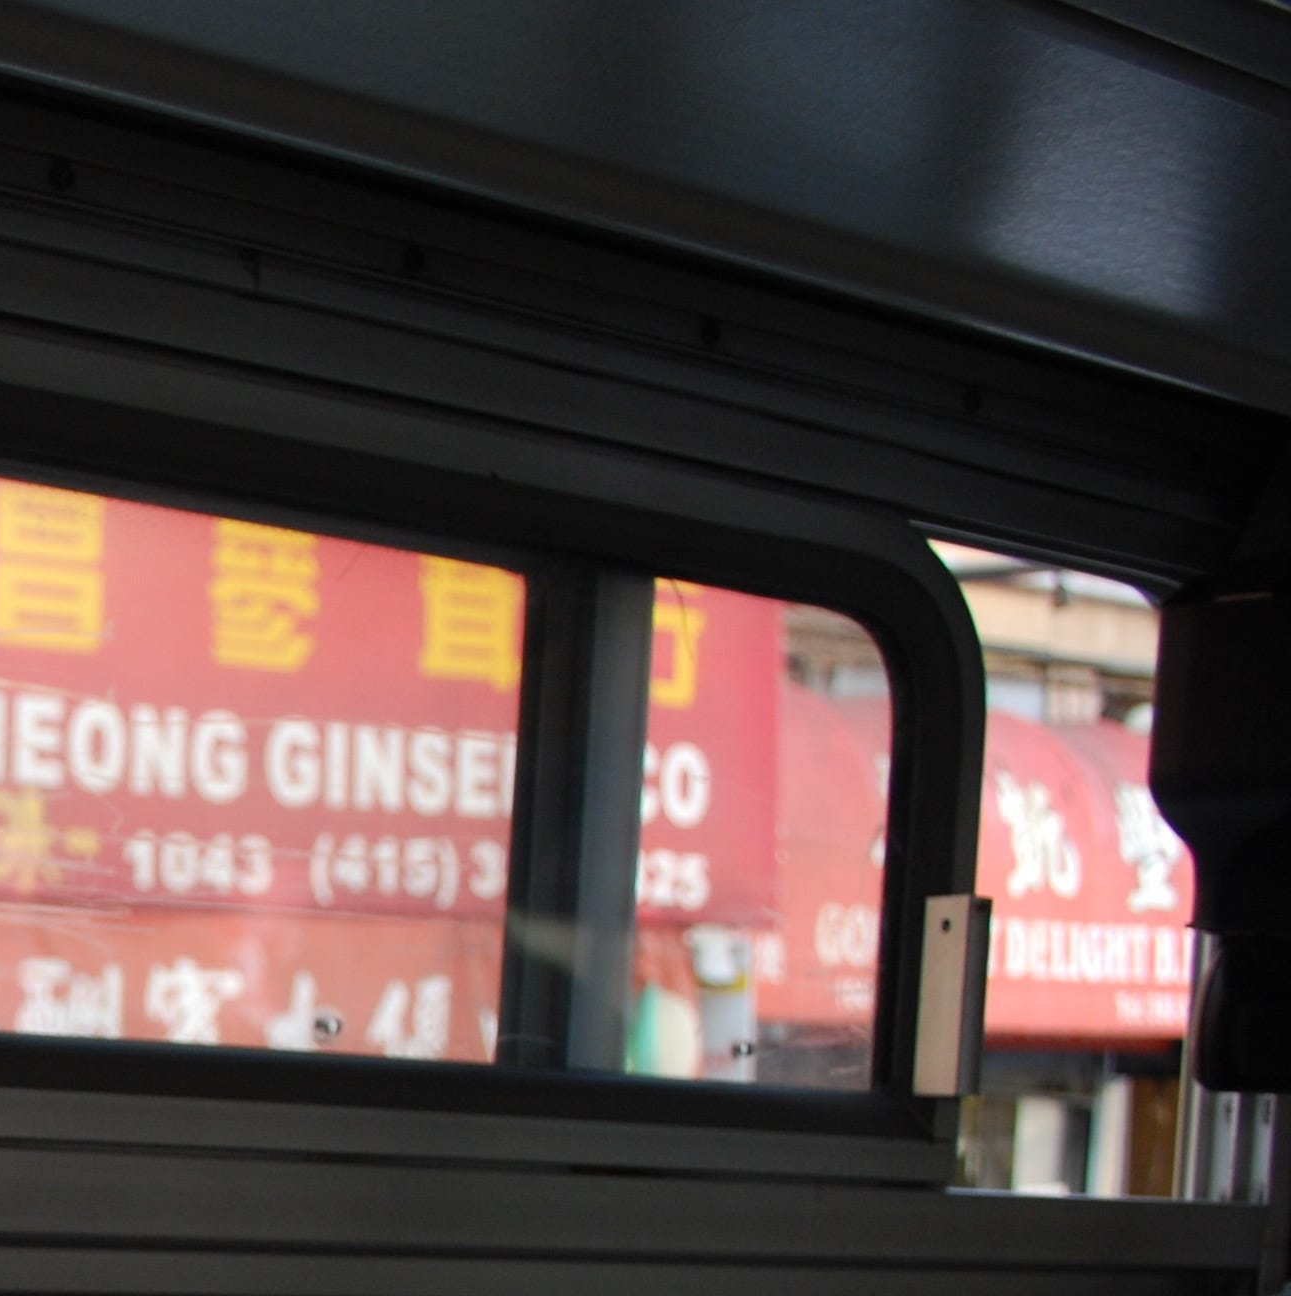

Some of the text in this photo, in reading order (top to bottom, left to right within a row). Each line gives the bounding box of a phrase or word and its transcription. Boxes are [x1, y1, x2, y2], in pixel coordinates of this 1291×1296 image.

[124, 830, 275, 898] 1043
[308, 832, 461, 909] (415)
[1004, 915, 1149, 984] DELIGHT
